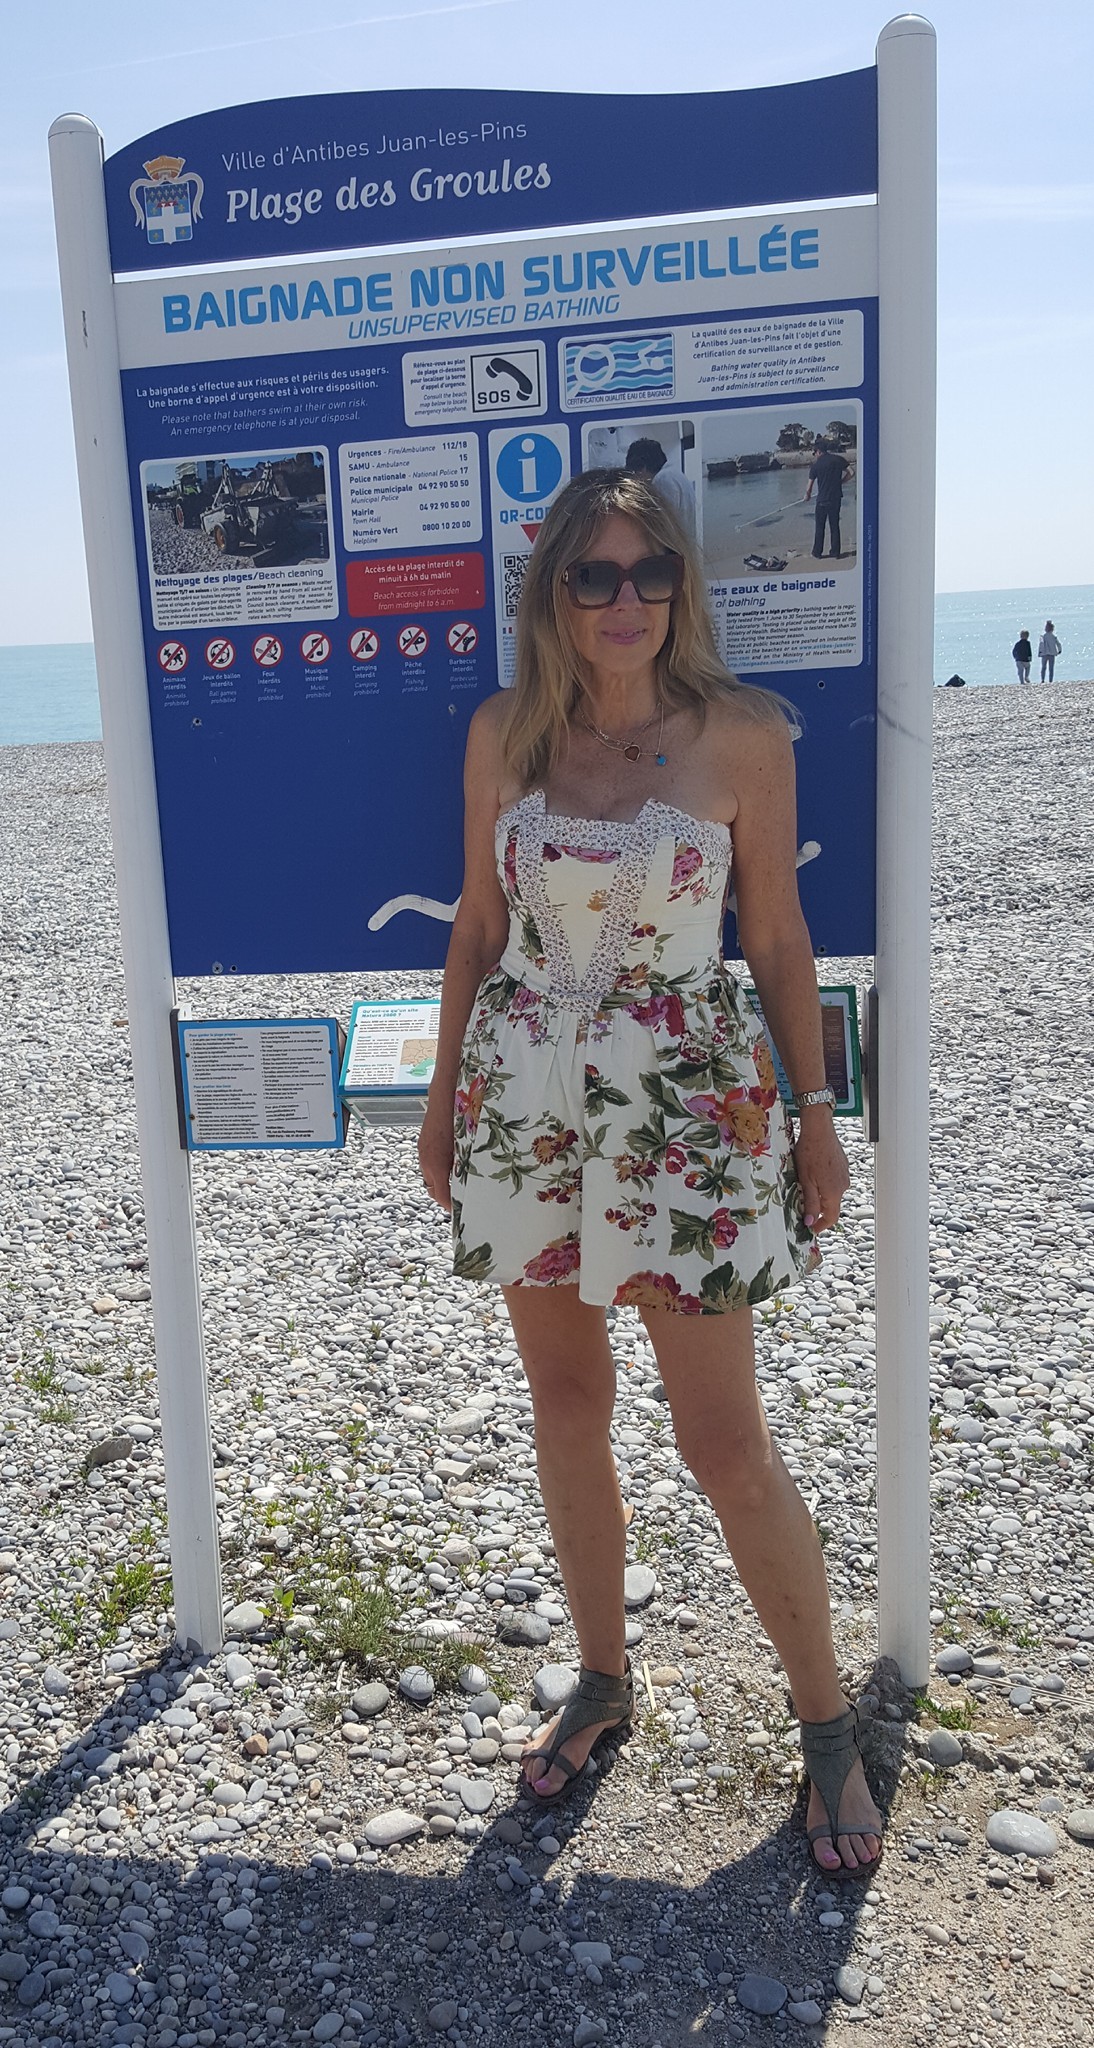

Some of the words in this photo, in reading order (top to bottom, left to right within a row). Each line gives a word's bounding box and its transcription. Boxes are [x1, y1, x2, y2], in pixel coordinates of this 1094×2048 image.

[222, 151, 265, 172] Ville
[272, 140, 370, 166] d'Antibes
[376, 121, 527, 154] Juan-les-Pins
[227, 188, 322, 224] Plage
[336, 177, 396, 211] des
[410, 159, 551, 201] Groules
[162, 272, 393, 333] BAIGNADE
[410, 260, 505, 308] NON
[524, 224, 818, 297] SURVEILLÉE
[348, 304, 517, 339] UNSUPERVISED
[523, 294, 620, 322] BATHING
[703, 327, 727, 338] qualité
[774, 321, 806, 331] baignade
[694, 340, 728, 349] d'Antibes
[730, 335, 781, 345] Juan-les-Pins
[782, 332, 794, 340] fait
[796, 331, 819, 339] l'objet
[693, 350, 736, 359] certification
[748, 344, 793, 354] surveillance
[803, 341, 812, 349] de
[814, 339, 843, 349] gestion.
[711, 363, 738, 372] Bathing
[740, 361, 761, 369] water
[763, 358, 788, 368] quality
[798, 355, 826, 364] Antibes
[136, 389, 147, 397] La
[150, 384, 189, 396] baignade
[191, 380, 235, 392] s'effectue
[237, 379, 253, 387] aux
[255, 375, 289, 386] risques
[303, 371, 328, 383] périls
[331, 370, 347, 379] des
[349, 367, 389, 377] usagers.
[698, 372, 748, 384] Juan-les-Pins
[758, 369, 784, 379] subject
[795, 365, 840, 375] surveillance
[726, 379, 778, 391] administration
[780, 376, 826, 386] certification.
[148, 400, 165, 408] Une
[168, 398, 193, 407] borne
[196, 393, 228, 404] d'appel
[231, 389, 275, 401] d'urgence
[277, 388, 291, 396] est
[293, 386, 298, 395] à
[301, 385, 324, 394] votre
[326, 380, 378, 392] disposition.
[478, 390, 510, 404] SOS
[161, 415, 190, 424] Please
[193, 413, 211, 421] note
[214, 410, 231, 420] that
[233, 408, 266, 418] bathers
[269, 404, 291, 415] swim
[294, 405, 302, 413] at
[305, 402, 325, 411] their
[328, 401, 346, 409] own
[349, 397, 367, 407] risk.
[170, 427, 182, 436] An
[185, 424, 232, 435] emergency
[234, 420, 276, 430] telephone
[289, 417, 297, 425] at
[300, 415, 319, 427] your
[322, 411, 360, 423] disposal.
[348, 449, 381, 459] Urgences
[443, 441, 467, 450] 112/18
[348, 462, 370, 471] SAMU
[376, 460, 410, 469] Ambulance
[350, 475, 371, 483] Police
[373, 472, 406, 482] nationale
[350, 487, 372, 496] Police
[374, 485, 413, 495] municipale
[352, 508, 374, 516] Mairie
[353, 527, 381, 537] Numéro
[365, 566, 385, 574] Accès
[406, 562, 426, 572] plage
[427, 561, 454, 569] interdit
[155, 577, 200, 588] Nettoyage
[204, 575, 220, 583] des
[223, 571, 285, 585] plages/Beach
[288, 569, 324, 580] cleaning
[379, 575, 402, 584] minuit
[420, 572, 429, 580] du
[431, 571, 451, 579] matin
[731, 585, 760, 595] eaux
[763, 583, 778, 592] de
[781, 578, 836, 592] baignade
[716, 599, 727, 608] of
[728, 597, 765, 608] bathing
